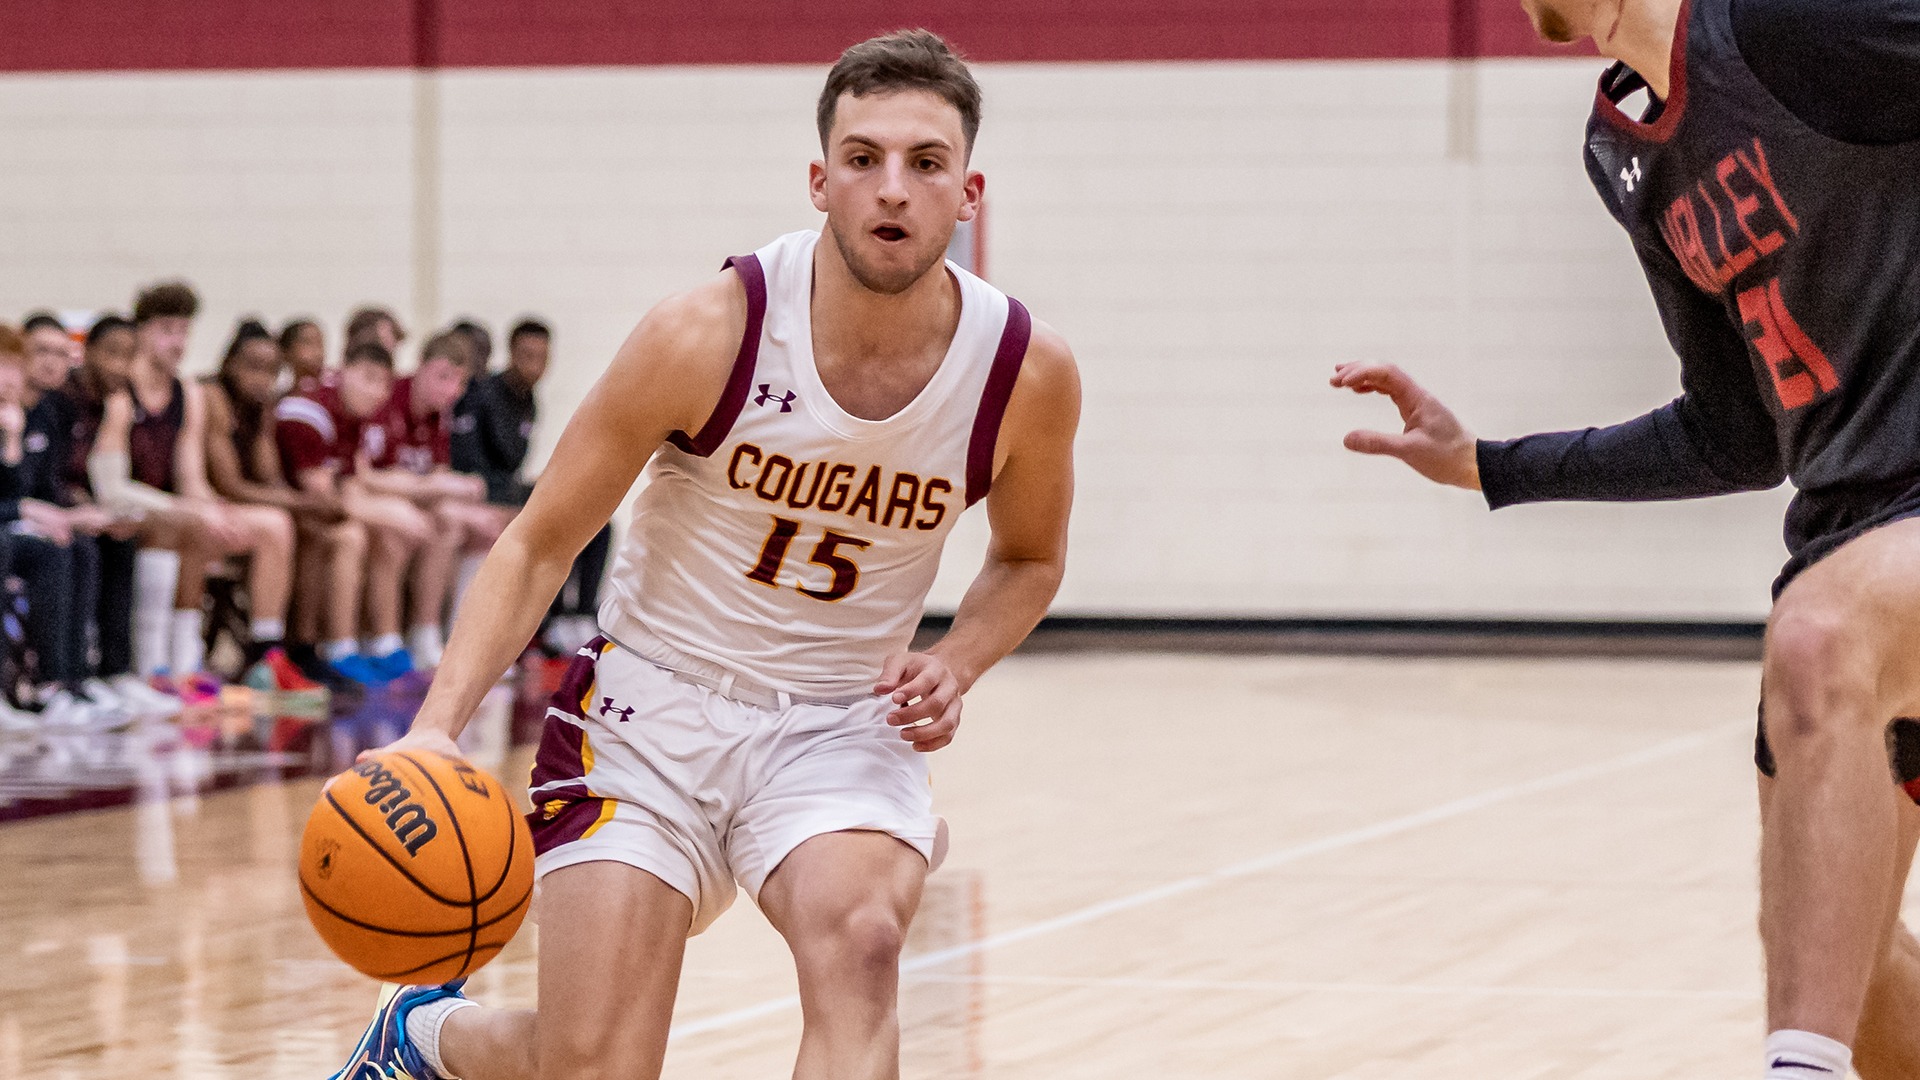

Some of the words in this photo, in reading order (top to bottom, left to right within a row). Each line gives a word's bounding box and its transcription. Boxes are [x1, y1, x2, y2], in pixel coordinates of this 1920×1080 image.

[1657, 137, 1799, 294] VALLEY
[1736, 277, 1839, 410] 21
[727, 442, 952, 531] COUGARS
[744, 514, 874, 603] 15
